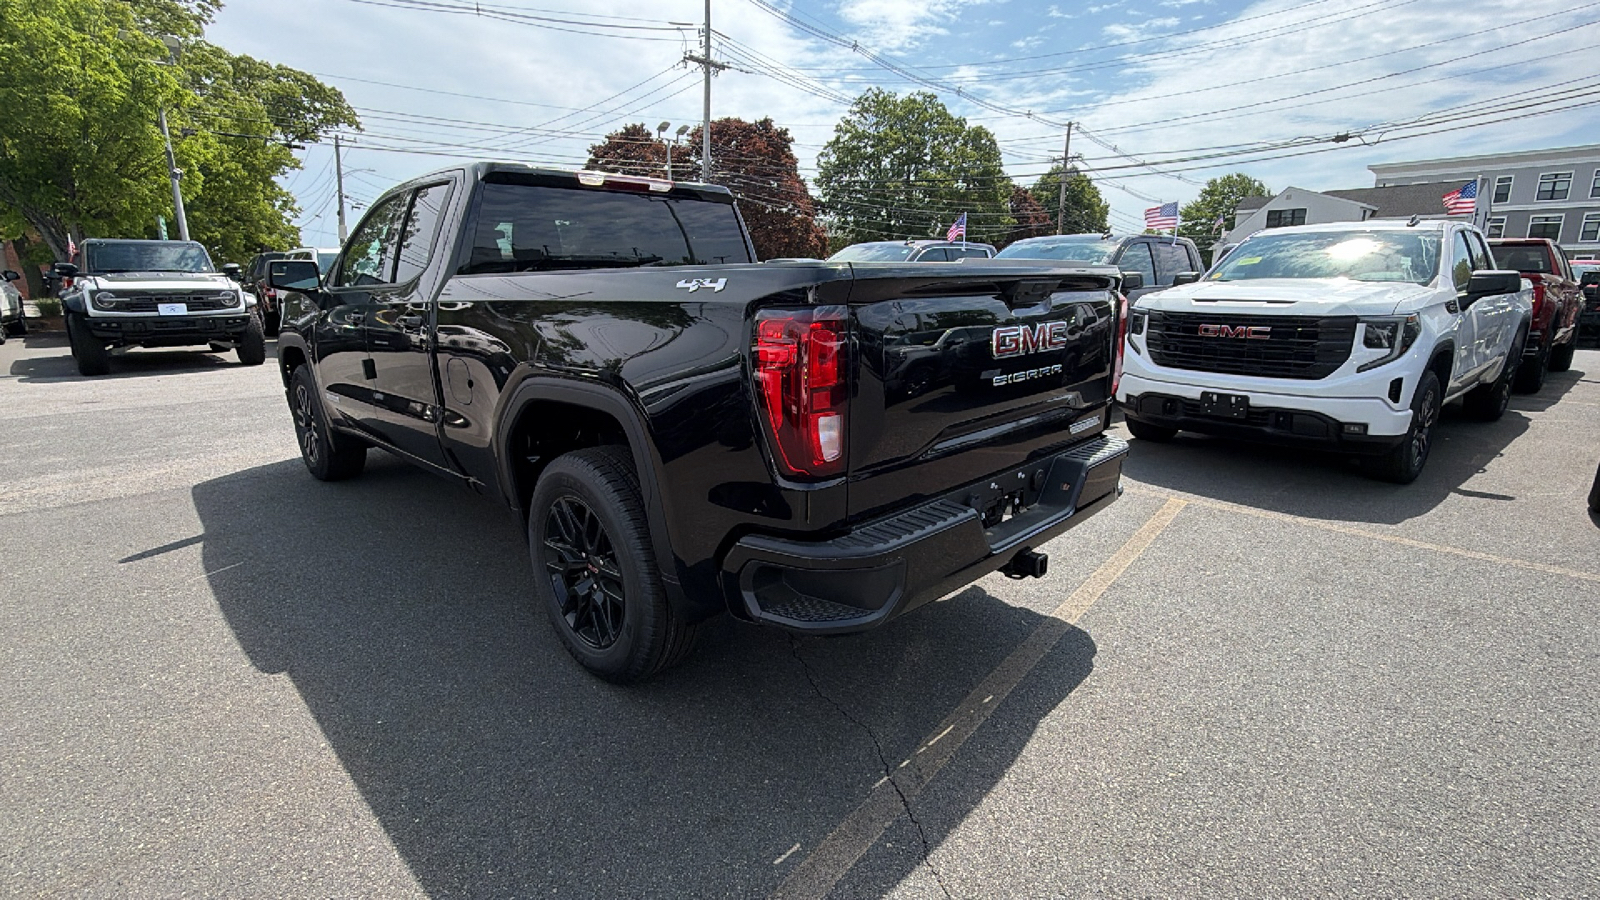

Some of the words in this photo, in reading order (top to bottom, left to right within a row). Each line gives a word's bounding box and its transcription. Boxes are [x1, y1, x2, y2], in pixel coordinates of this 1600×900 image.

[992, 321, 1068, 359] GMC
[1198, 323, 1272, 340] GMC
[992, 363, 1063, 386] SIERRA
